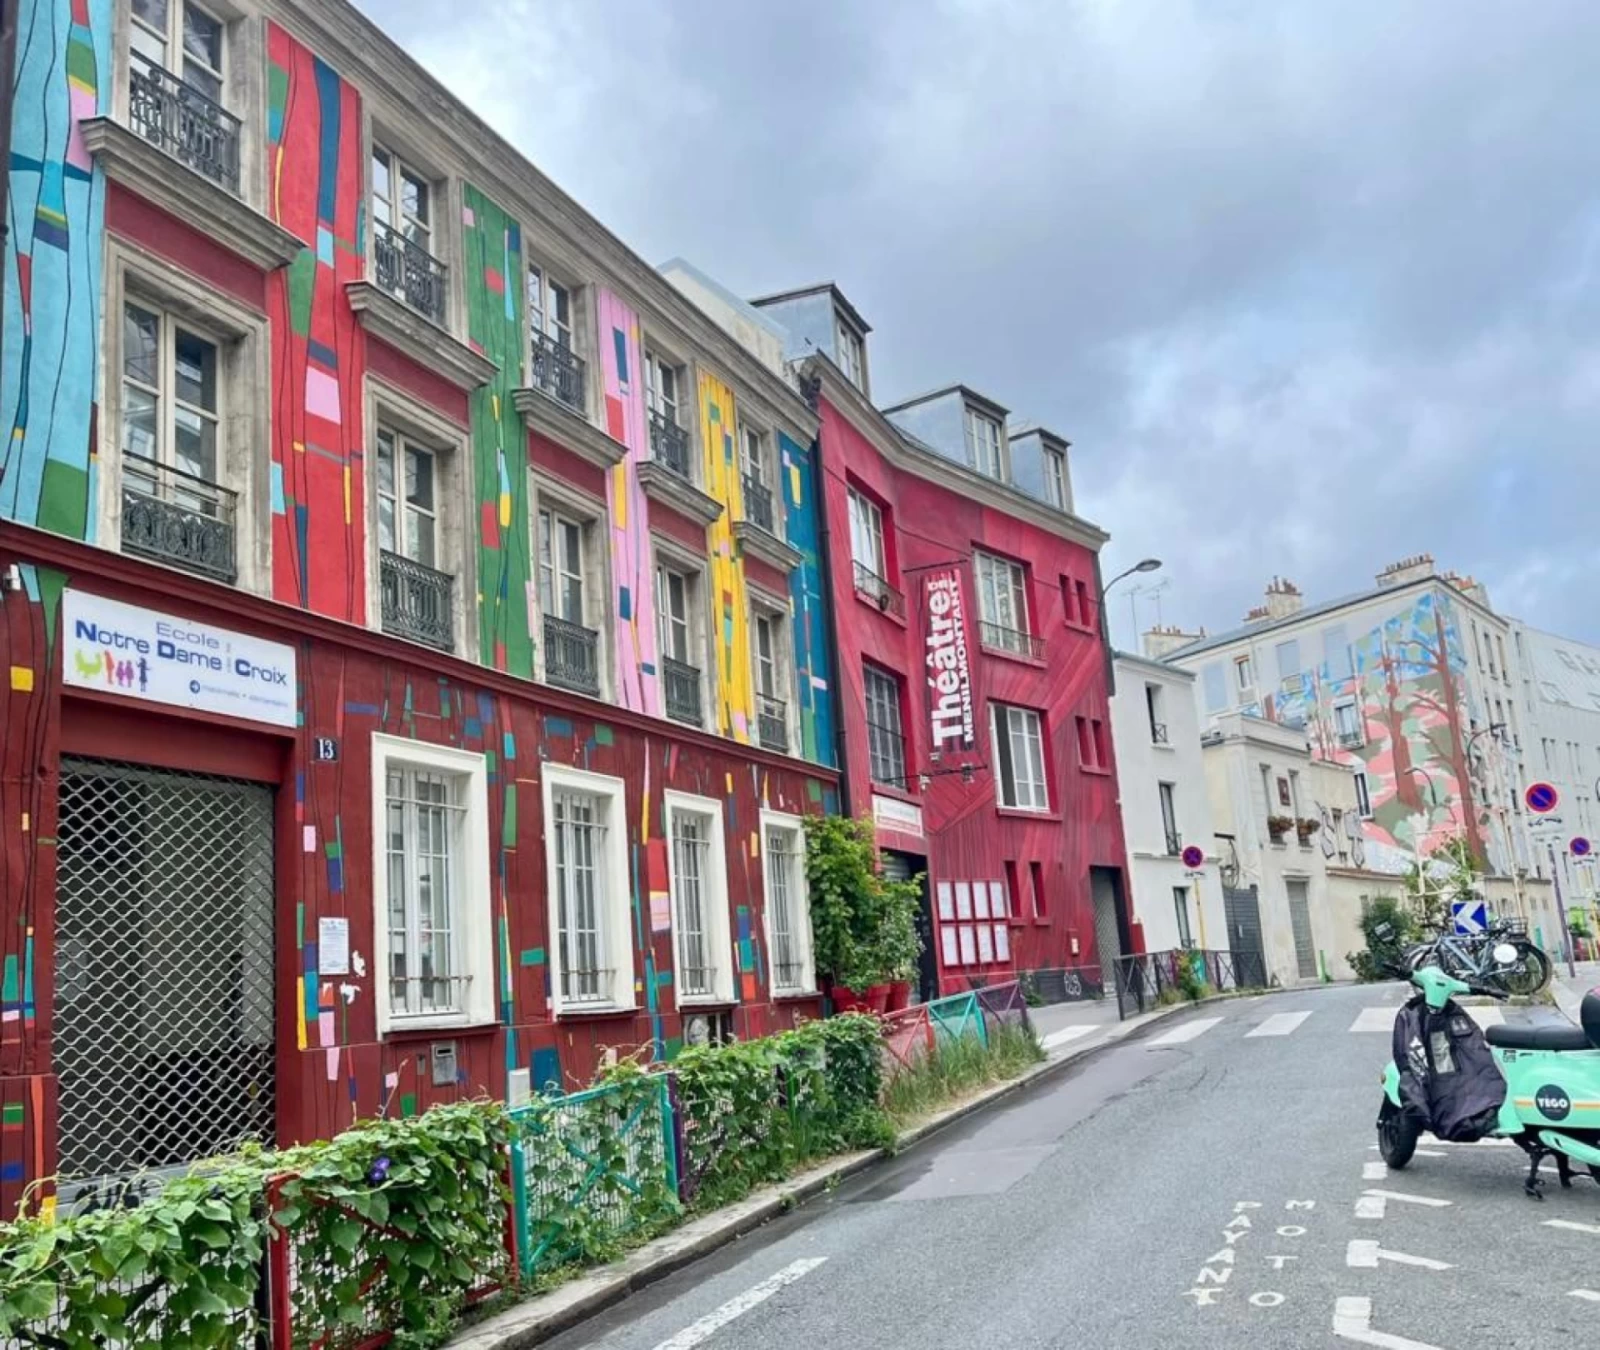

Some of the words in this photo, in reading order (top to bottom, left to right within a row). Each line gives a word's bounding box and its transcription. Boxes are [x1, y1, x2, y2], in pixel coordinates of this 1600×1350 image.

[75, 620, 150, 654] Notre
[157, 640, 222, 671] Dame
[235, 658, 287, 686] Croix
[155, 621, 220, 649] Ecole
[926, 590, 963, 747] Théâtre
[949, 572, 974, 742] MENILMONTANT
[319, 738, 334, 759] 13
[1249, 1200, 1316, 1306] MOTO
